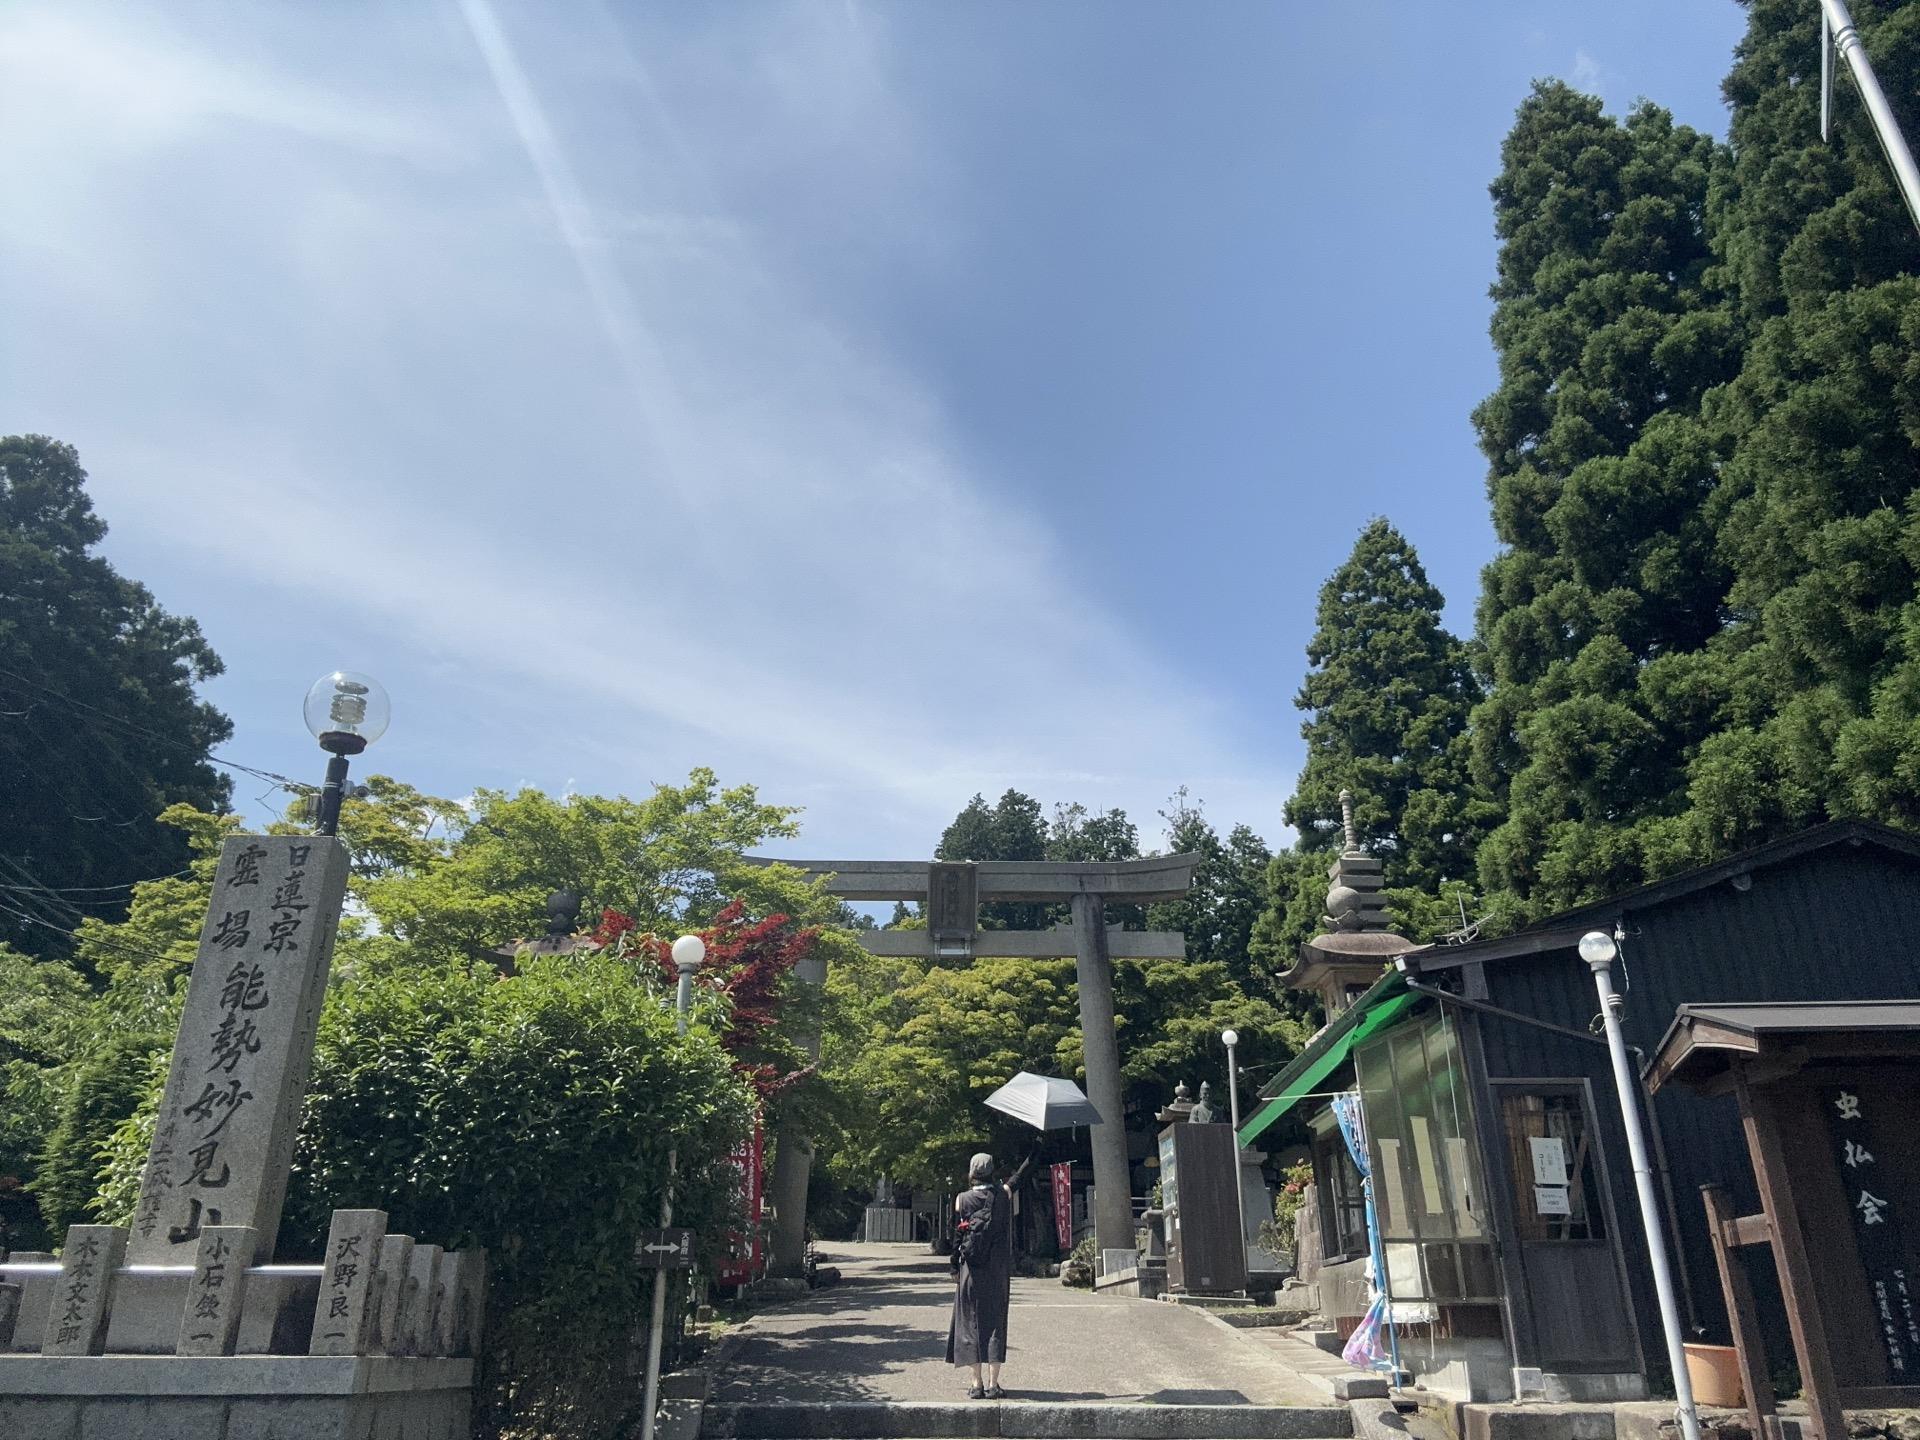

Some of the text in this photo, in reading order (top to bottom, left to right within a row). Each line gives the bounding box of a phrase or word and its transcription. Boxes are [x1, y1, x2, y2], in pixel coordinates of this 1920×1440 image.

[263, 844, 311, 956] 日蓮宗
[1834, 1090, 1888, 1225] 虫払会
[324, 1235, 363, 1339] 沢野良一
